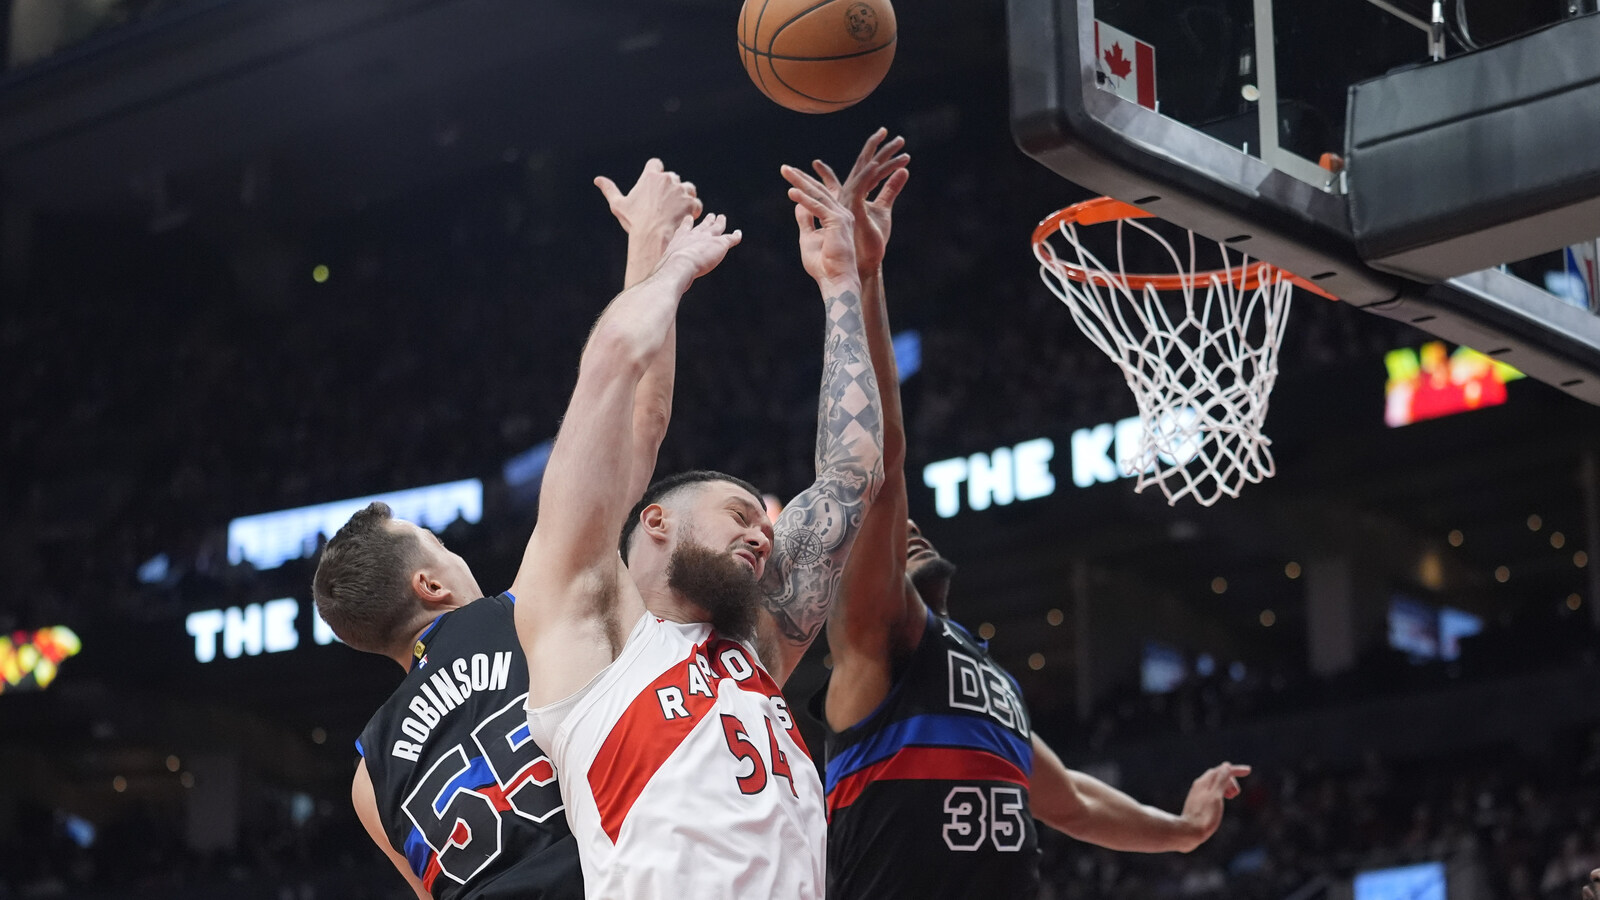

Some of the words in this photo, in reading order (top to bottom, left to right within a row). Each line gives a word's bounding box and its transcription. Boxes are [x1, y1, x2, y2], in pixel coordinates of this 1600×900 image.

[922, 436, 1056, 519] THE
[185, 597, 300, 664] THE
[391, 651, 513, 763] ROBINSON
[401, 692, 566, 885] 55
[719, 713, 800, 800] 54
[942, 786, 1027, 852] 35
